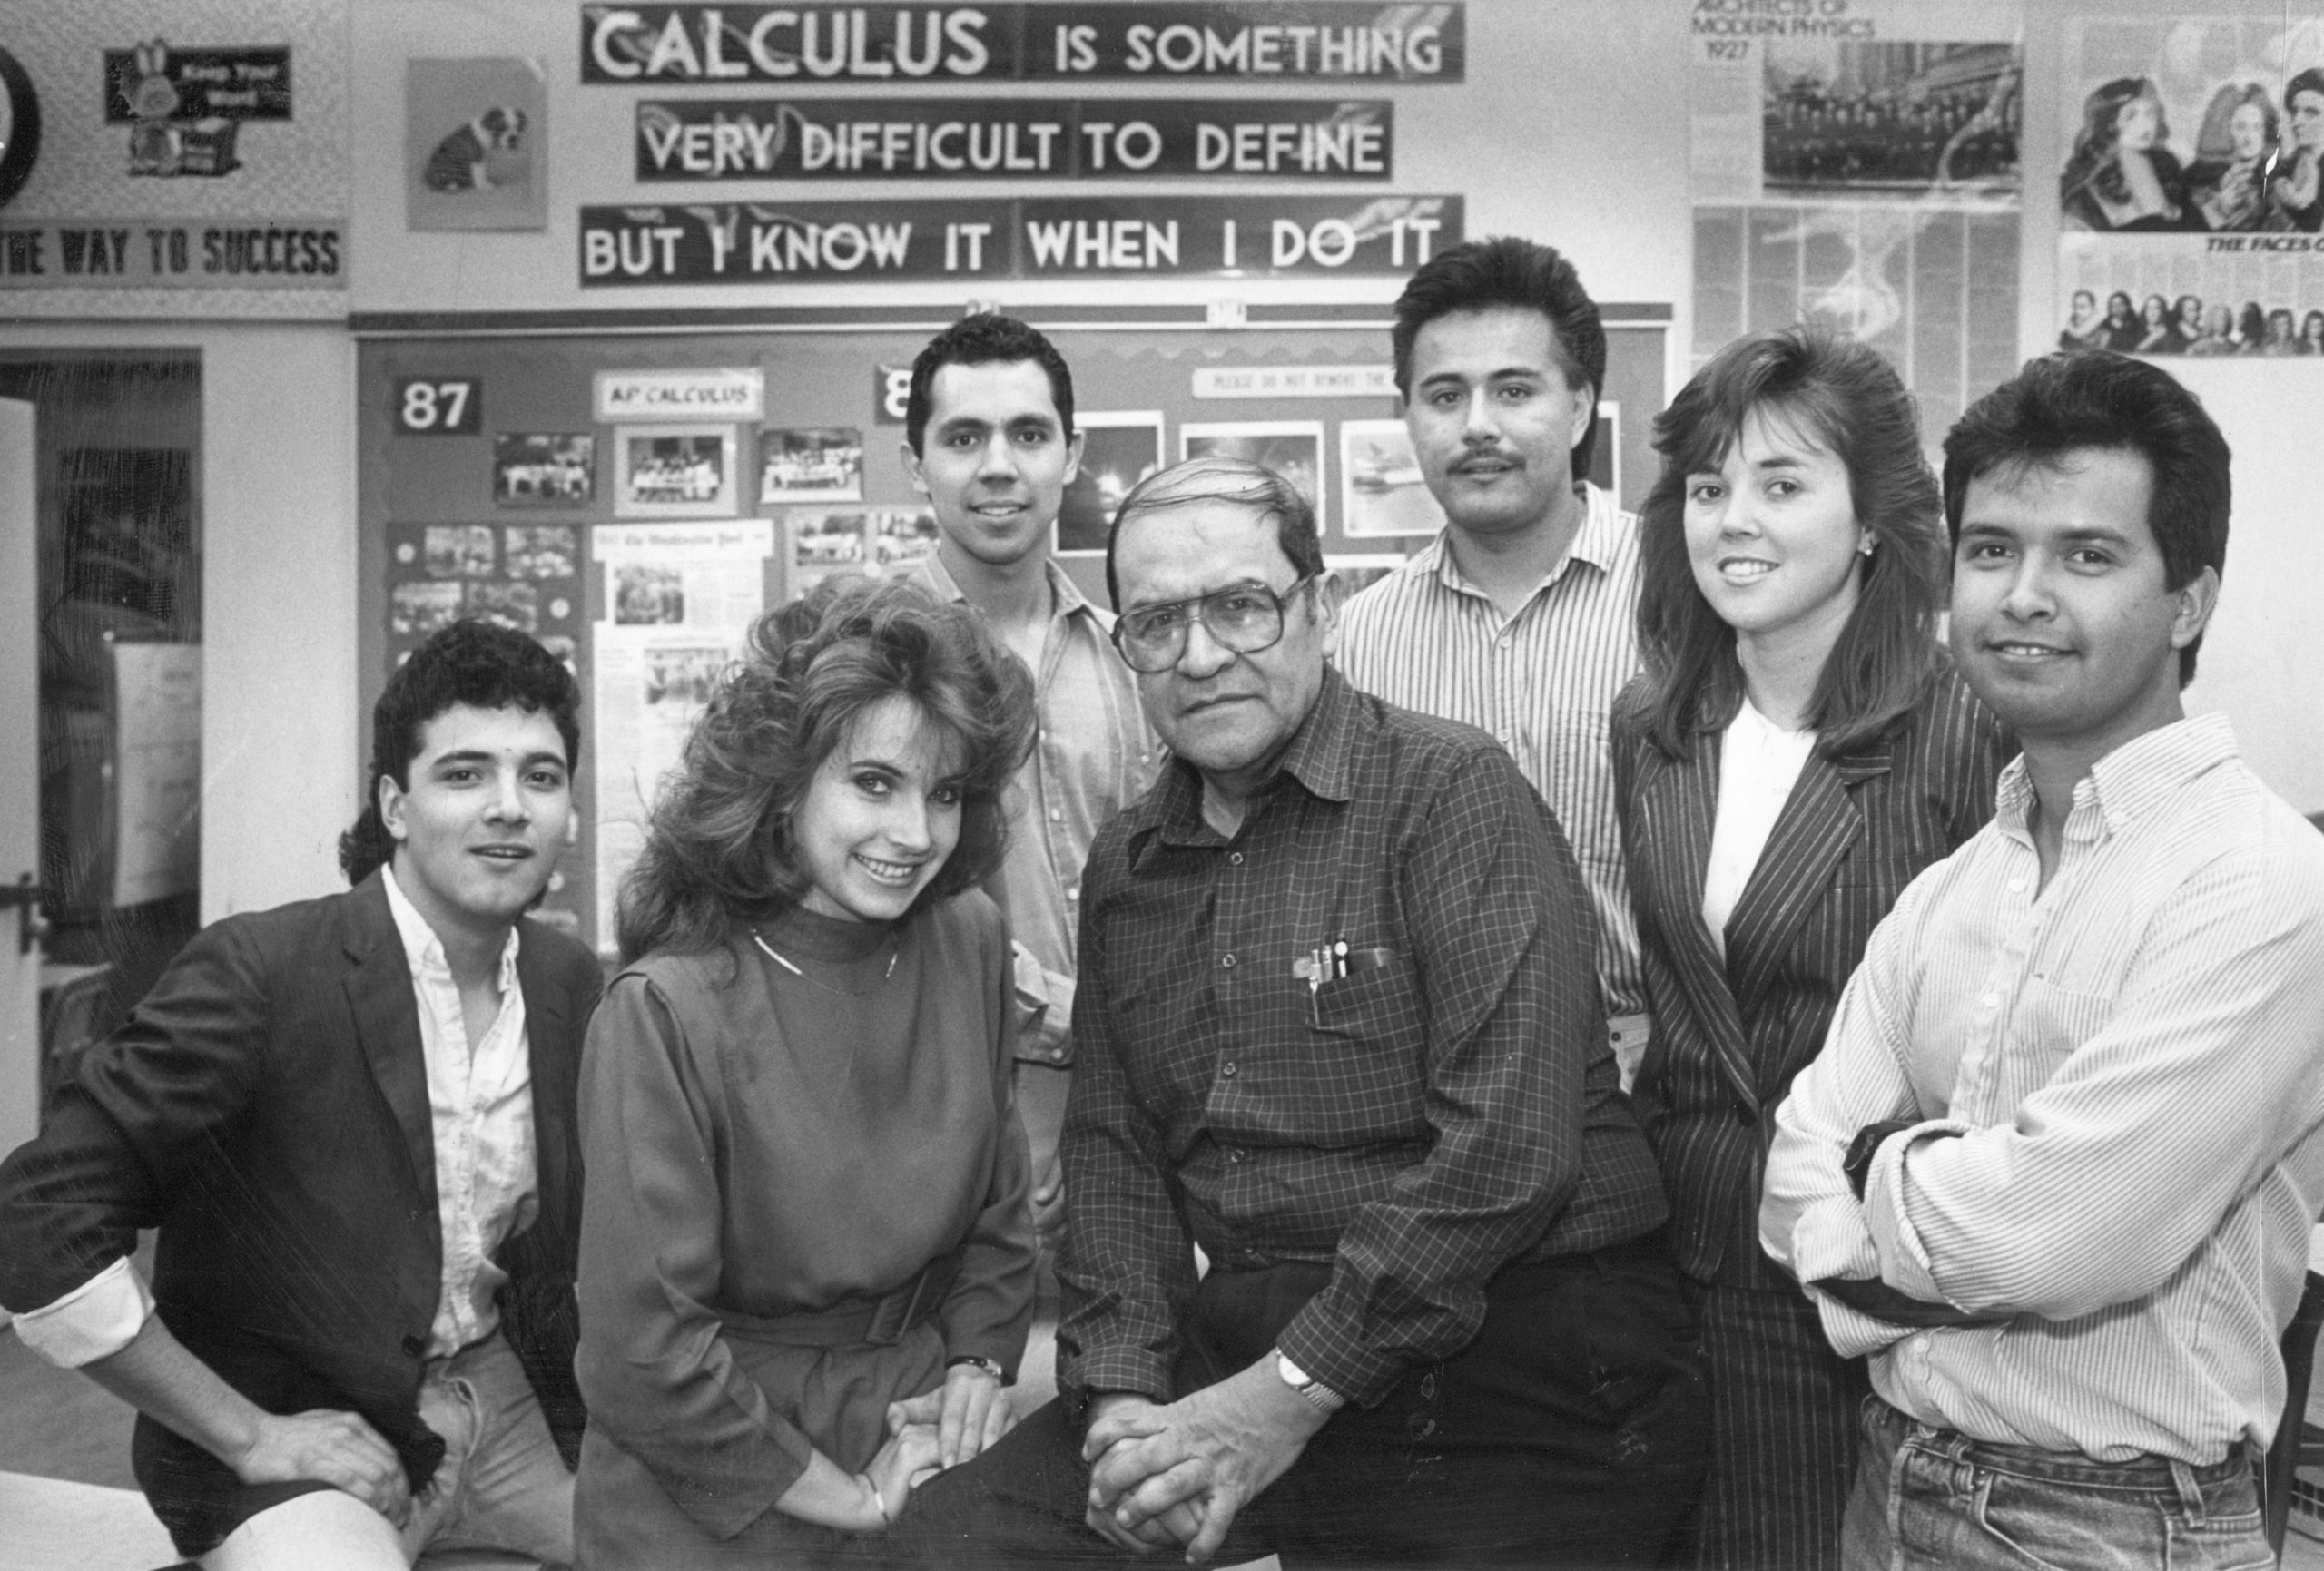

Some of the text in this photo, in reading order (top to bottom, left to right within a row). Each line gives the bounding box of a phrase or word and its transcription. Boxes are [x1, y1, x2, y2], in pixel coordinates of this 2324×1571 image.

[592, 7, 1443, 78] CALCULUS IS SOMETHING
[1691, 18, 1876, 38] MODERN PHYSICS
[1706, 40, 1749, 60] 1927
[643, 120, 1385, 172] VERY DIFFICULT TO DEFINE
[58, 229, 132, 275] WAY
[145, 229, 188, 274] TO
[203, 228, 340, 275] SUCCESS
[585, 218, 1442, 275] BUT I KNOW IT WHEN I DO IT
[2207, 237, 2244, 251] THE
[2250, 237, 2310, 251] FACES
[402, 382, 470, 428] 87
[645, 384, 748, 403] CALCULUS
